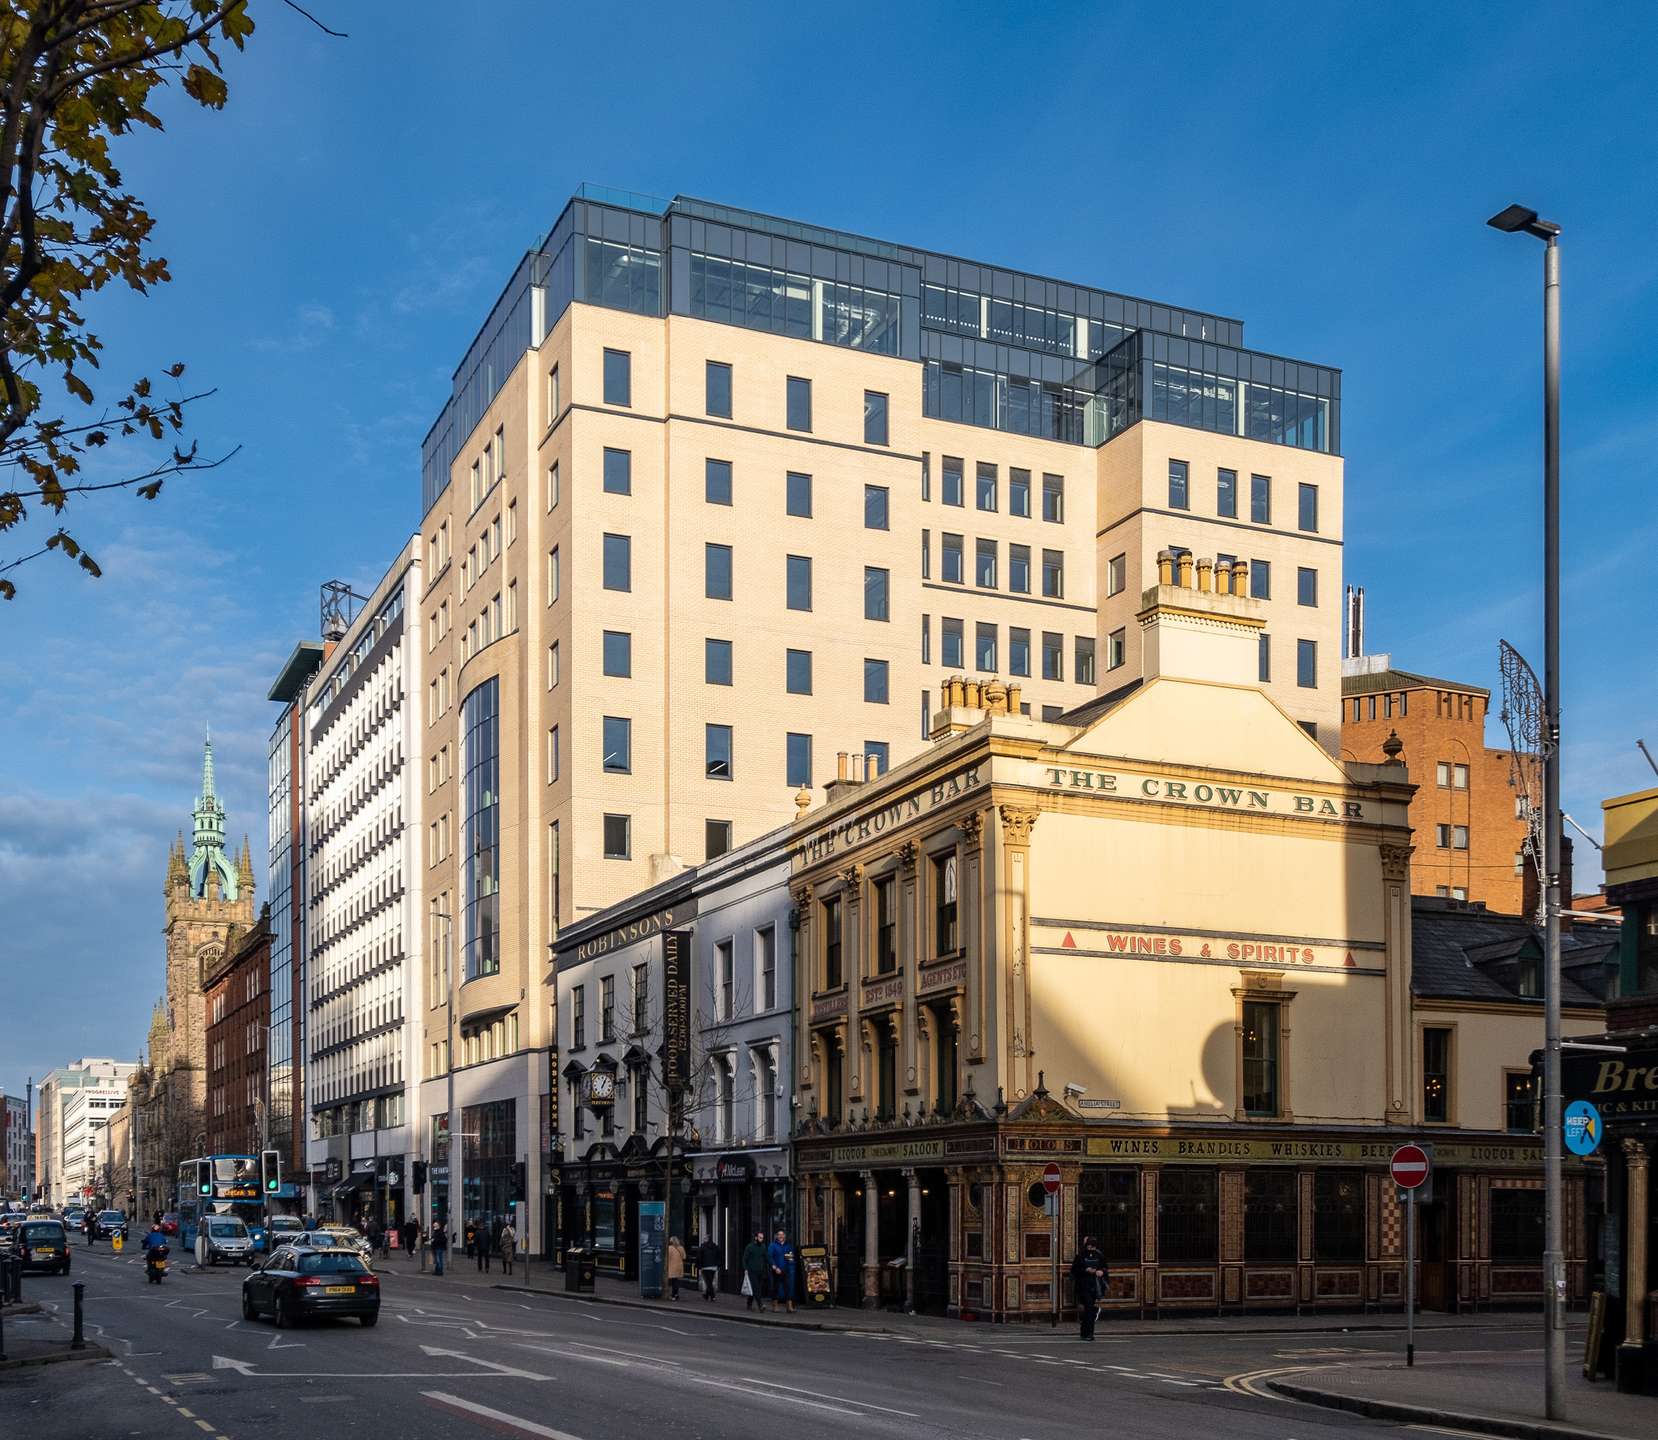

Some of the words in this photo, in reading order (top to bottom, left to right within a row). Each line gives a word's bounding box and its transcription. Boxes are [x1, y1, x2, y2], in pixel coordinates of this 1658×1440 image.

[1047, 768, 1117, 792] THE
[1141, 778, 1270, 808] CROWN
[1294, 796, 1364, 819] BAR
[800, 830, 835, 866] THE
[844, 797, 920, 847] CROWN
[930, 767, 980, 806] BAR
[577, 909, 673, 960] ROBINSONS
[1107, 934, 1183, 955] WINES
[1200, 943, 1211, 958] &
[1227, 943, 1315, 964] SPIRITS
[666, 933, 678, 975] DAILY
[667, 980, 679, 1038] SERVED
[1110, 1140, 1160, 1154] WINES
[1178, 1141, 1251, 1155] BRANDIES
[1271, 1143, 1343, 1157] WHISKIES
[1567, 1127, 1586, 1138] LEFT
[838, 1147, 866, 1161] LIQUOR
[903, 1142, 938, 1157] SALOON
[1471, 1148, 1514, 1161] LIQUOR
[1523, 1149, 1545, 1161] SAL
